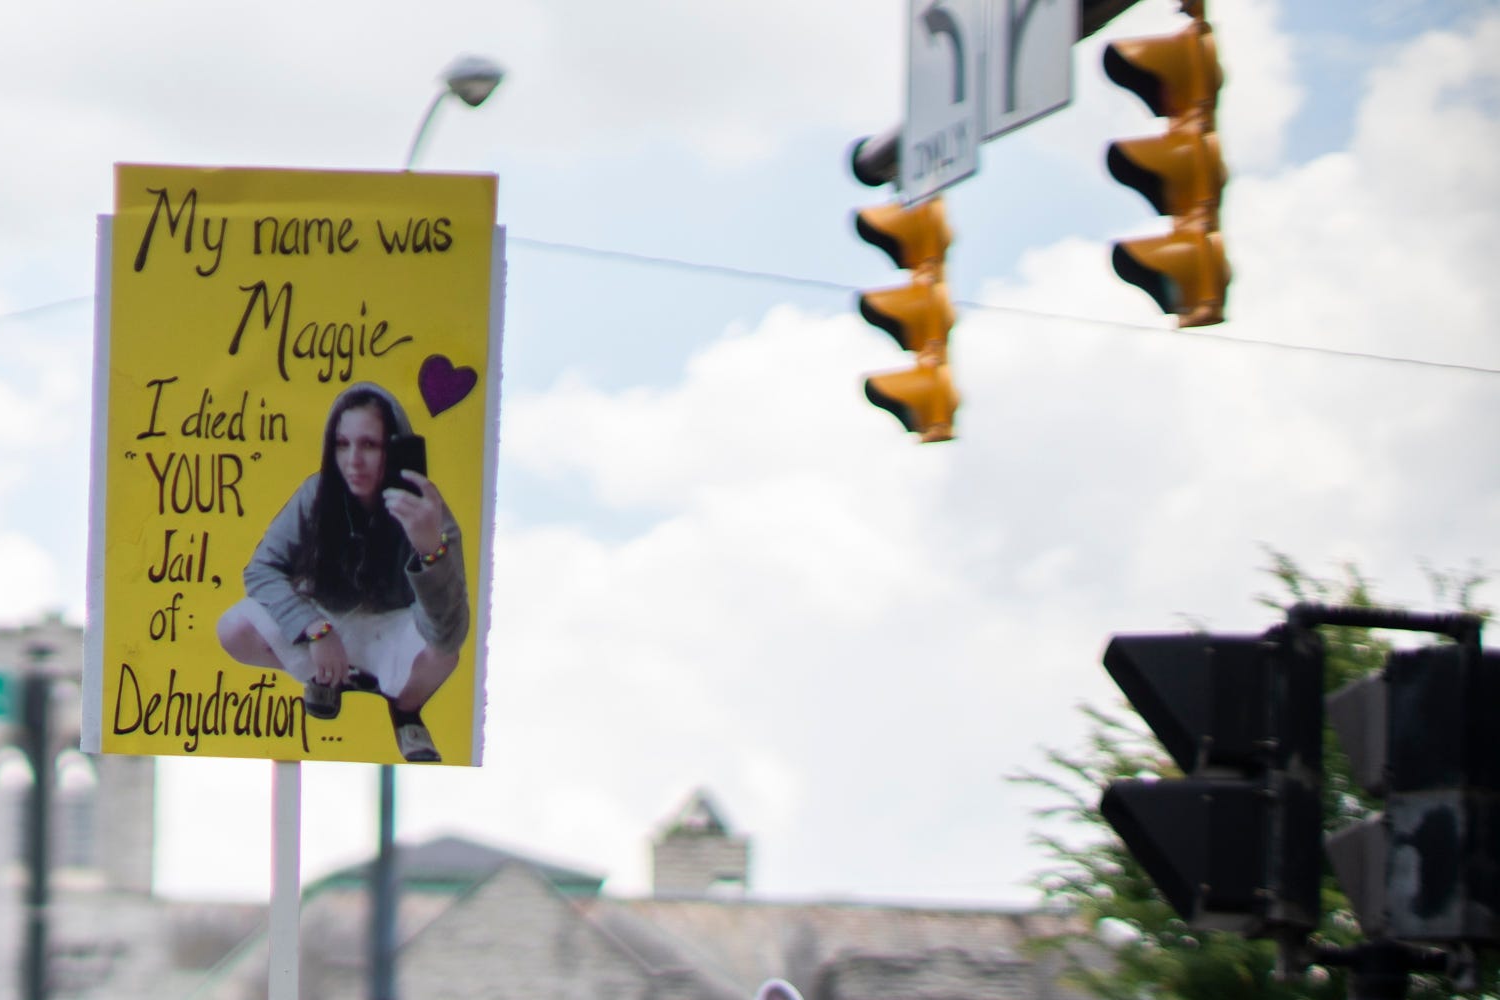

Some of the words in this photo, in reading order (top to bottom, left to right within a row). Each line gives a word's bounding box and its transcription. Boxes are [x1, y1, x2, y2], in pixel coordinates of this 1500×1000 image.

[133, 186, 228, 278] My
[252, 215, 360, 256] name
[376, 215, 455, 255] was
[228, 280, 415, 384] Maggie
[135, 376, 180, 442] I
[180, 388, 249, 442] died
[258, 396, 290, 443] in
[147, 529, 223, 590] Jail,
[148, 592, 196, 643] of:
